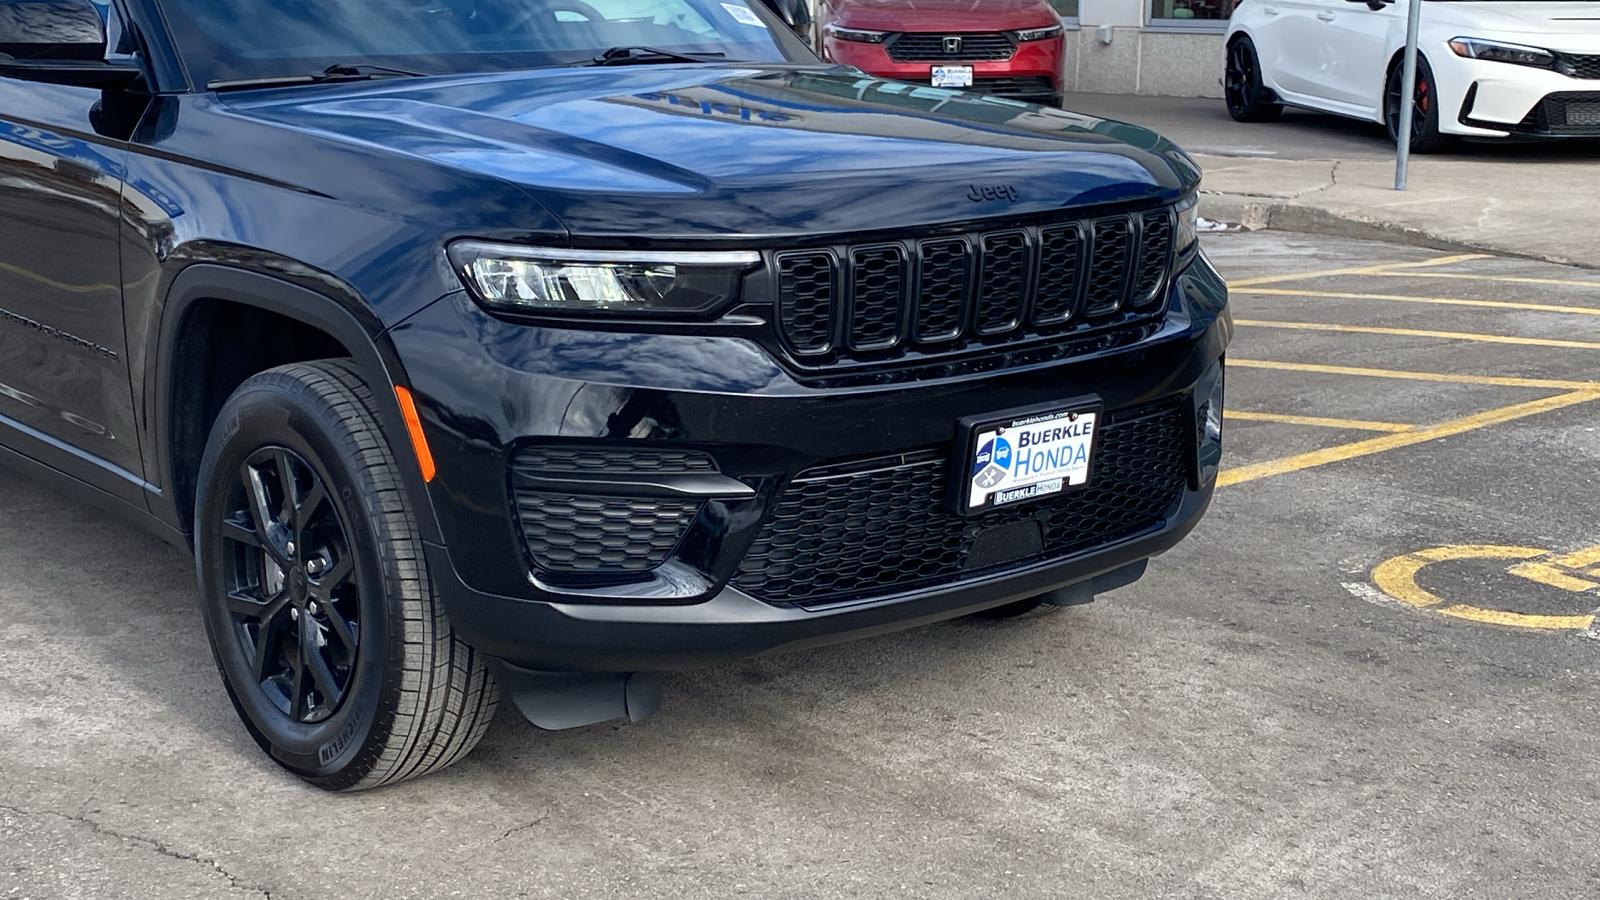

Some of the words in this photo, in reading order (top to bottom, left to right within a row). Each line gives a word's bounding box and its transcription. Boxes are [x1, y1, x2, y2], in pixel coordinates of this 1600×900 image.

[967, 183, 1019, 202] Jeep
[1018, 421, 1092, 448] BUERKLE
[1014, 442, 1087, 478] HONDA
[996, 485, 1036, 503] BUERKLE
[1036, 481, 1060, 494] HONDA
[321, 705, 363, 762] MICHELIN
